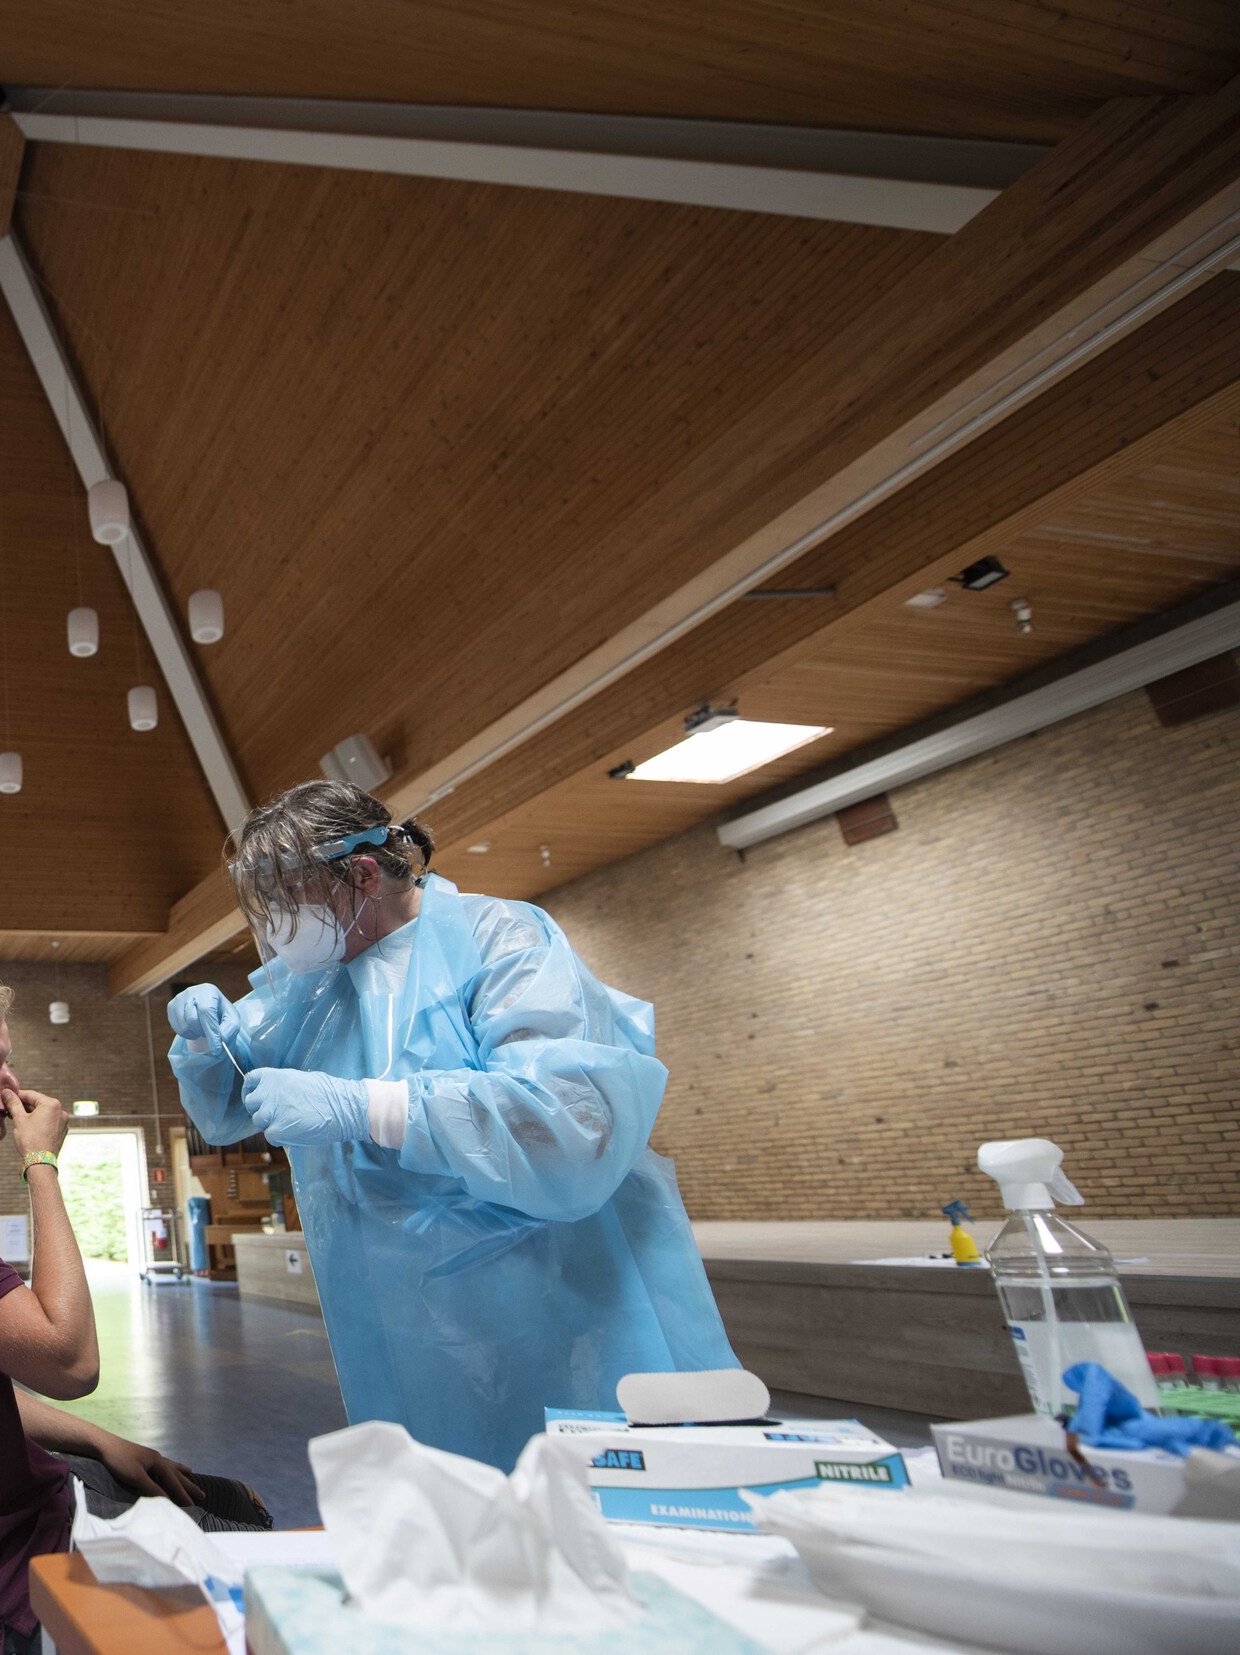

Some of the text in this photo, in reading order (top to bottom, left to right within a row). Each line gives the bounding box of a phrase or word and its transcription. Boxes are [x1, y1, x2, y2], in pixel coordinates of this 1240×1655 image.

[589, 1450, 643, 1469] SAFE
[946, 1434, 1133, 1491] EuroGloves
[818, 1463, 890, 1482] NITRILE
[650, 1503, 753, 1523] EXAMINATION
